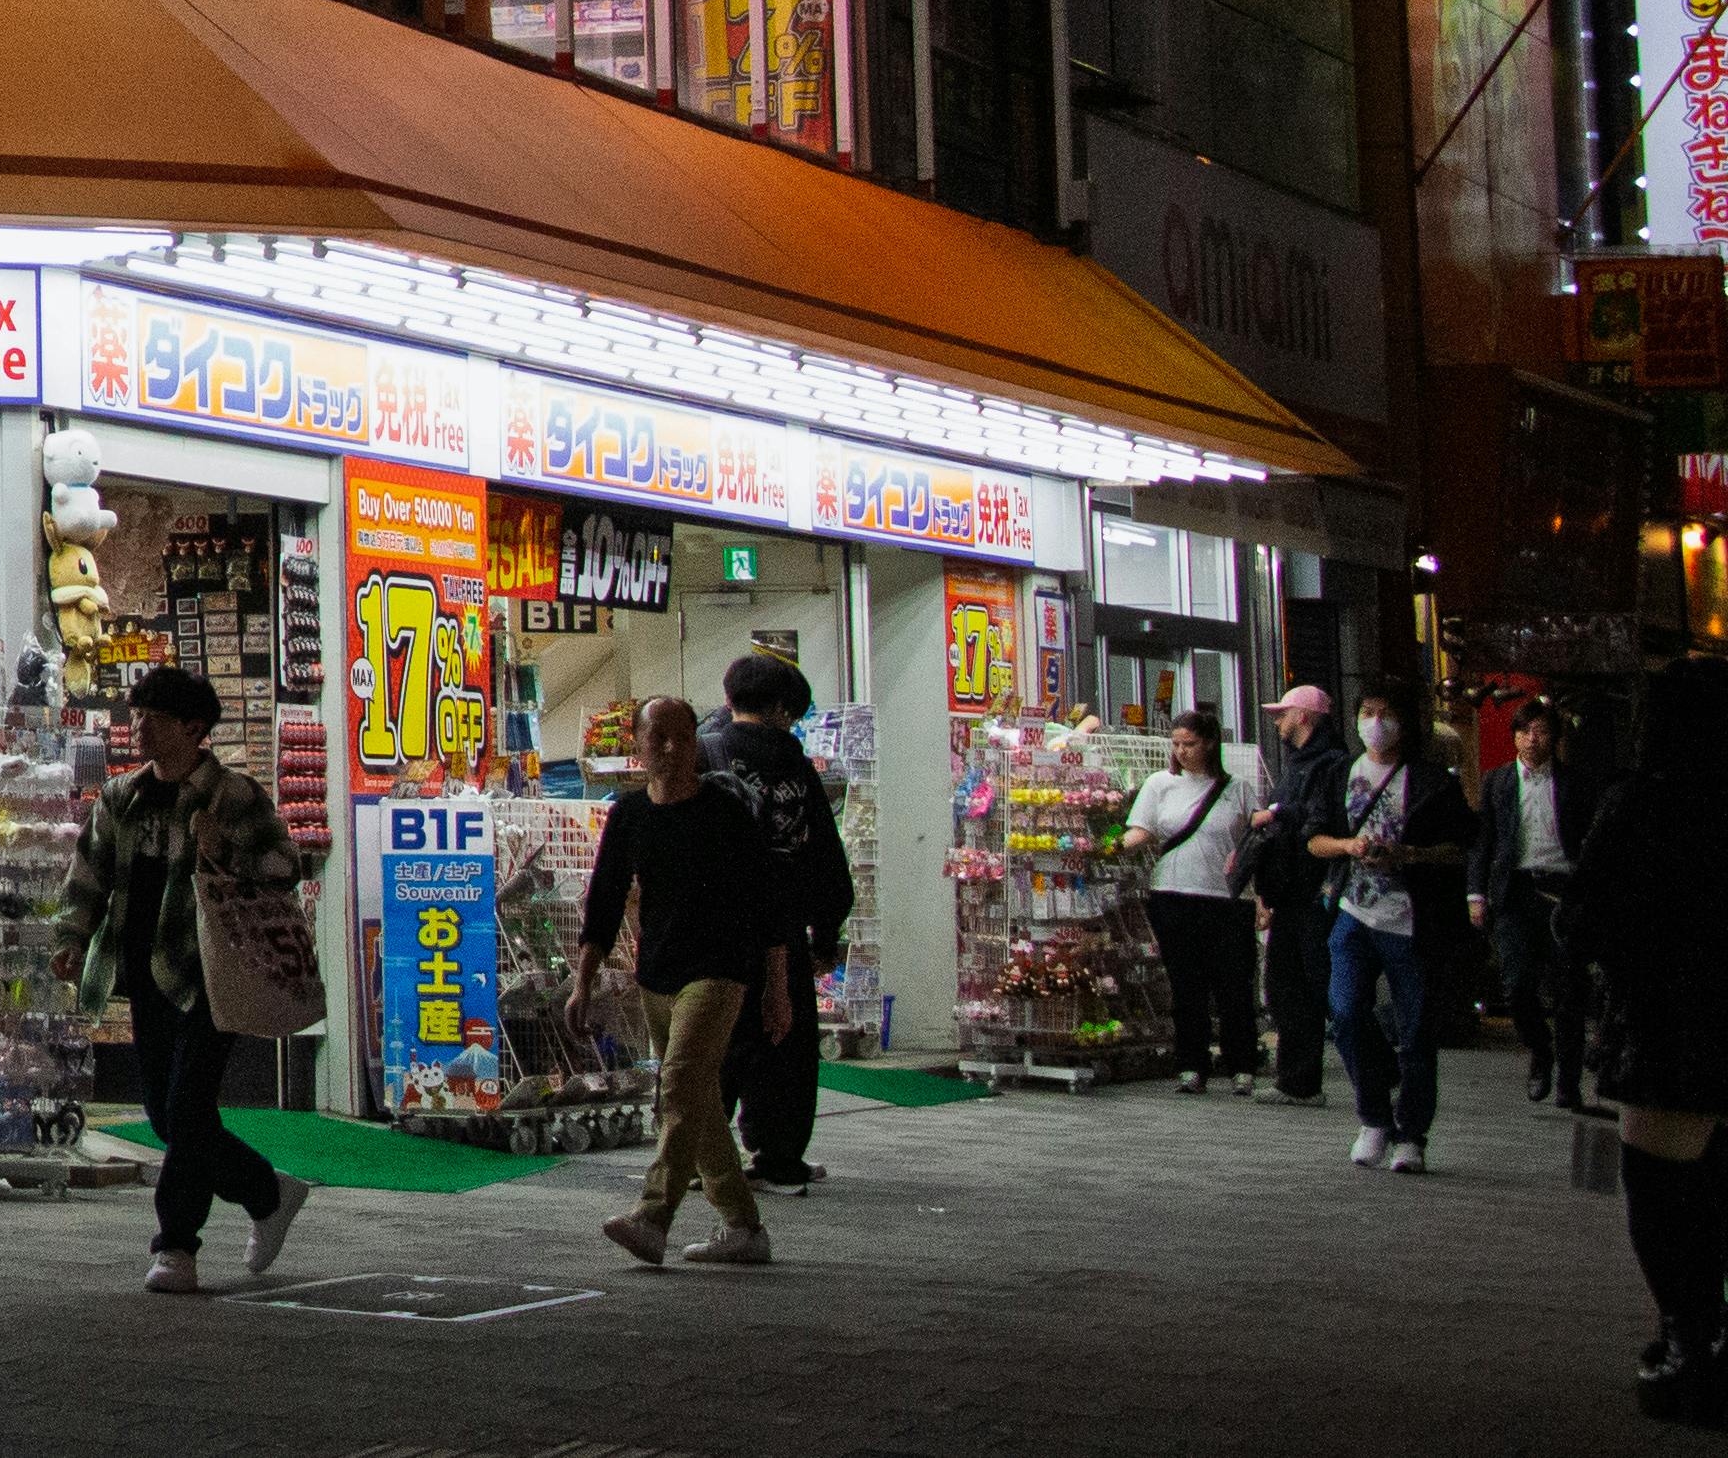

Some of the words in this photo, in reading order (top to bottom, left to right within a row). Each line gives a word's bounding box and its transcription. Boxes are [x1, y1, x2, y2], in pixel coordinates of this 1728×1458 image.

[87, 284, 131, 405] 薬
[374, 358, 430, 448] 免税
[433, 411, 465, 454] Free
[357, 488, 381, 521] Buy
[383, 492, 412, 522] Over
[414, 496, 453, 529] 50,000
[453, 502, 475, 531] Yen
[762, 472, 785, 510] Free
[977, 482, 1011, 546] 免税
[1013, 485, 1030, 518] Tax
[1012, 518, 1032, 550] Free
[576, 512, 672, 604] 10%OFF
[527, 600, 591, 630] B1F
[98, 644, 149, 664] SALE
[352, 668, 374, 687] MAX
[60, 707, 87, 727] 980
[439, 695, 483, 760] OFF
[1060, 751, 1084, 764] 600
[390, 808, 484, 851] B1F
[395, 884, 482, 903] Souvenir
[418, 907, 464, 1045] お土産
